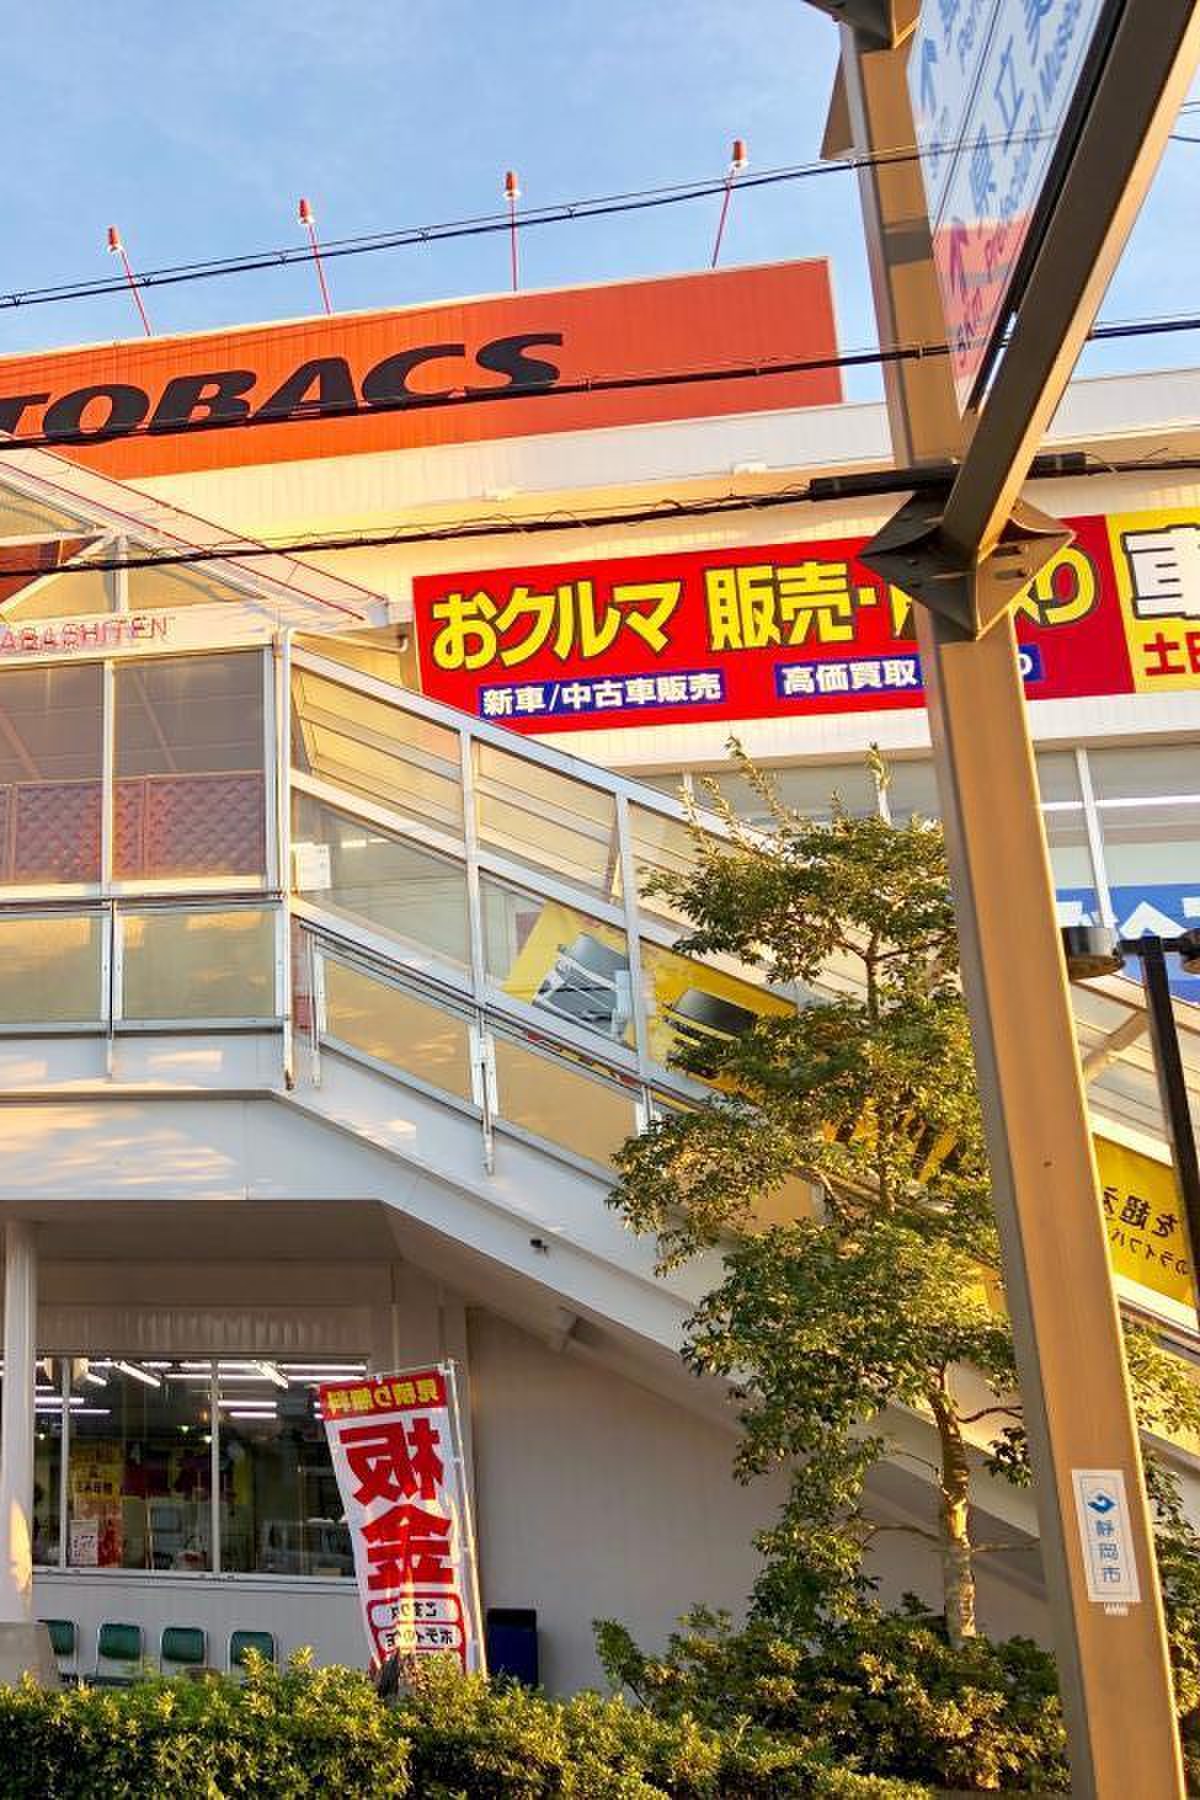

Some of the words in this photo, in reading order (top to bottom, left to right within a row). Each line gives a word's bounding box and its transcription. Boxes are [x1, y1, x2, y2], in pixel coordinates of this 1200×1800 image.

[431, 579, 682, 672] おクルマ
[483, 673, 722, 718] 新車/中古車販売
